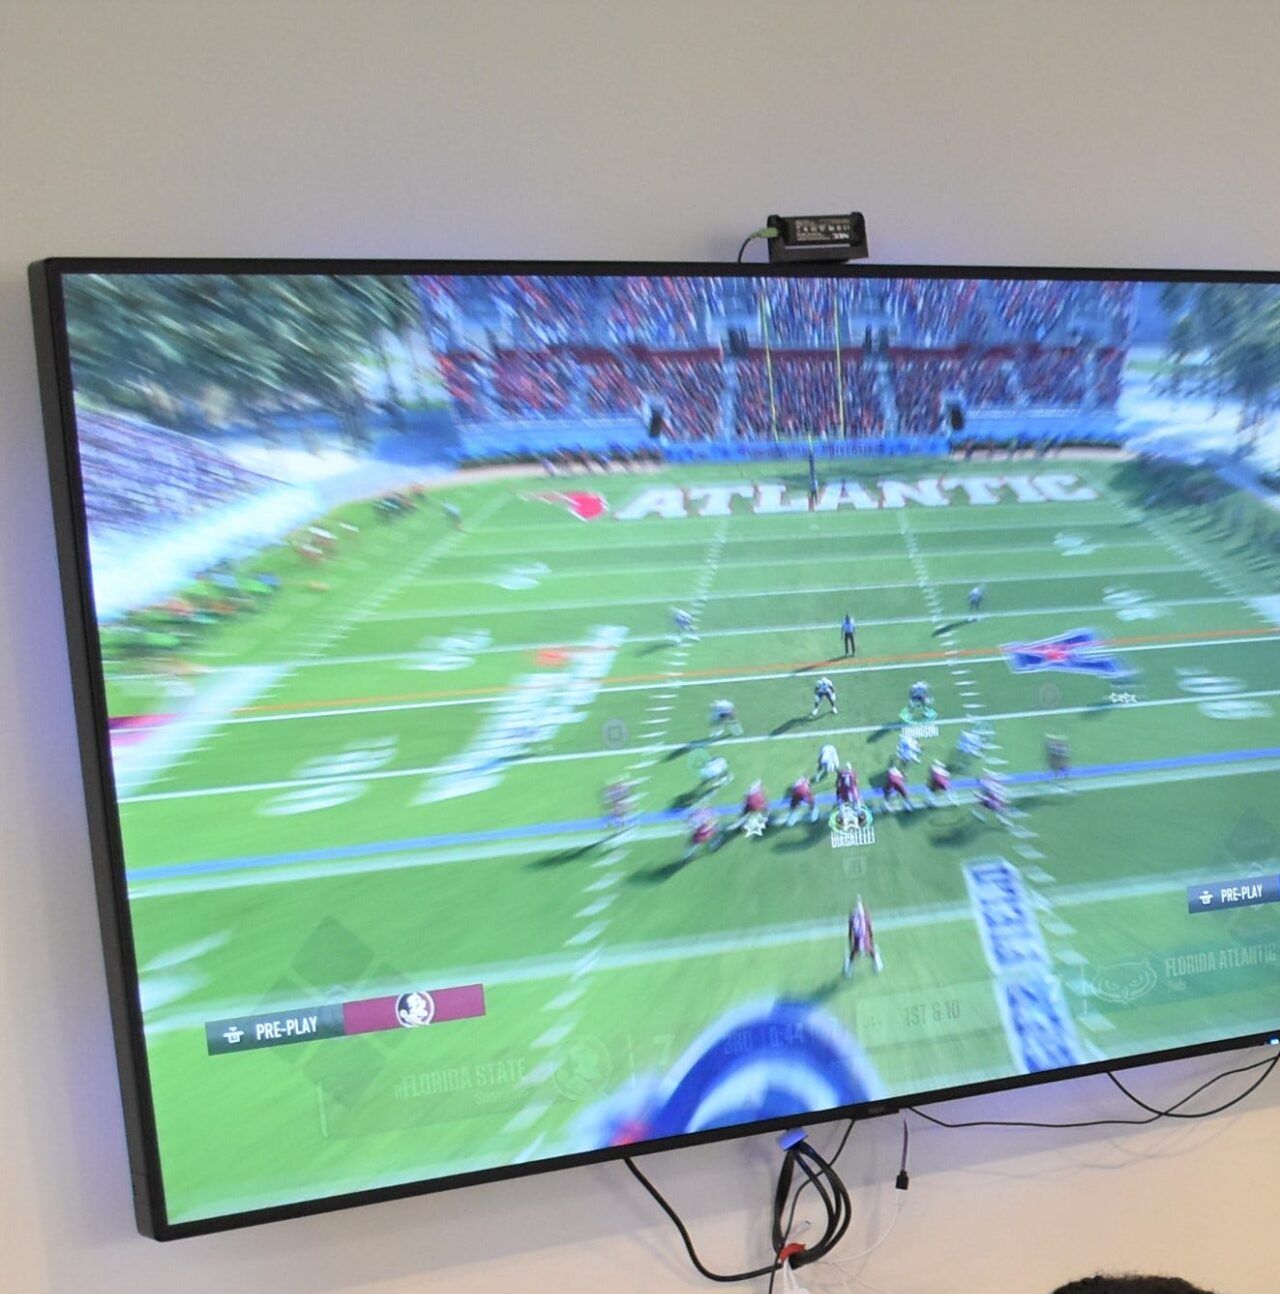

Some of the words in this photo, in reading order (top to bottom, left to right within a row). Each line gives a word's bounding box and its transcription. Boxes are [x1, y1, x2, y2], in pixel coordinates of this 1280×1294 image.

[614, 473, 1099, 520] ATLANTIC
[1220, 883, 1264, 904] PRE-PLAY
[1165, 951, 1217, 978] FLORIDA
[1219, 942, 1278, 970] ATLANTIC
[255, 1015, 319, 1041] PRE-PLAY
[476, 1056, 527, 1086] STATE
